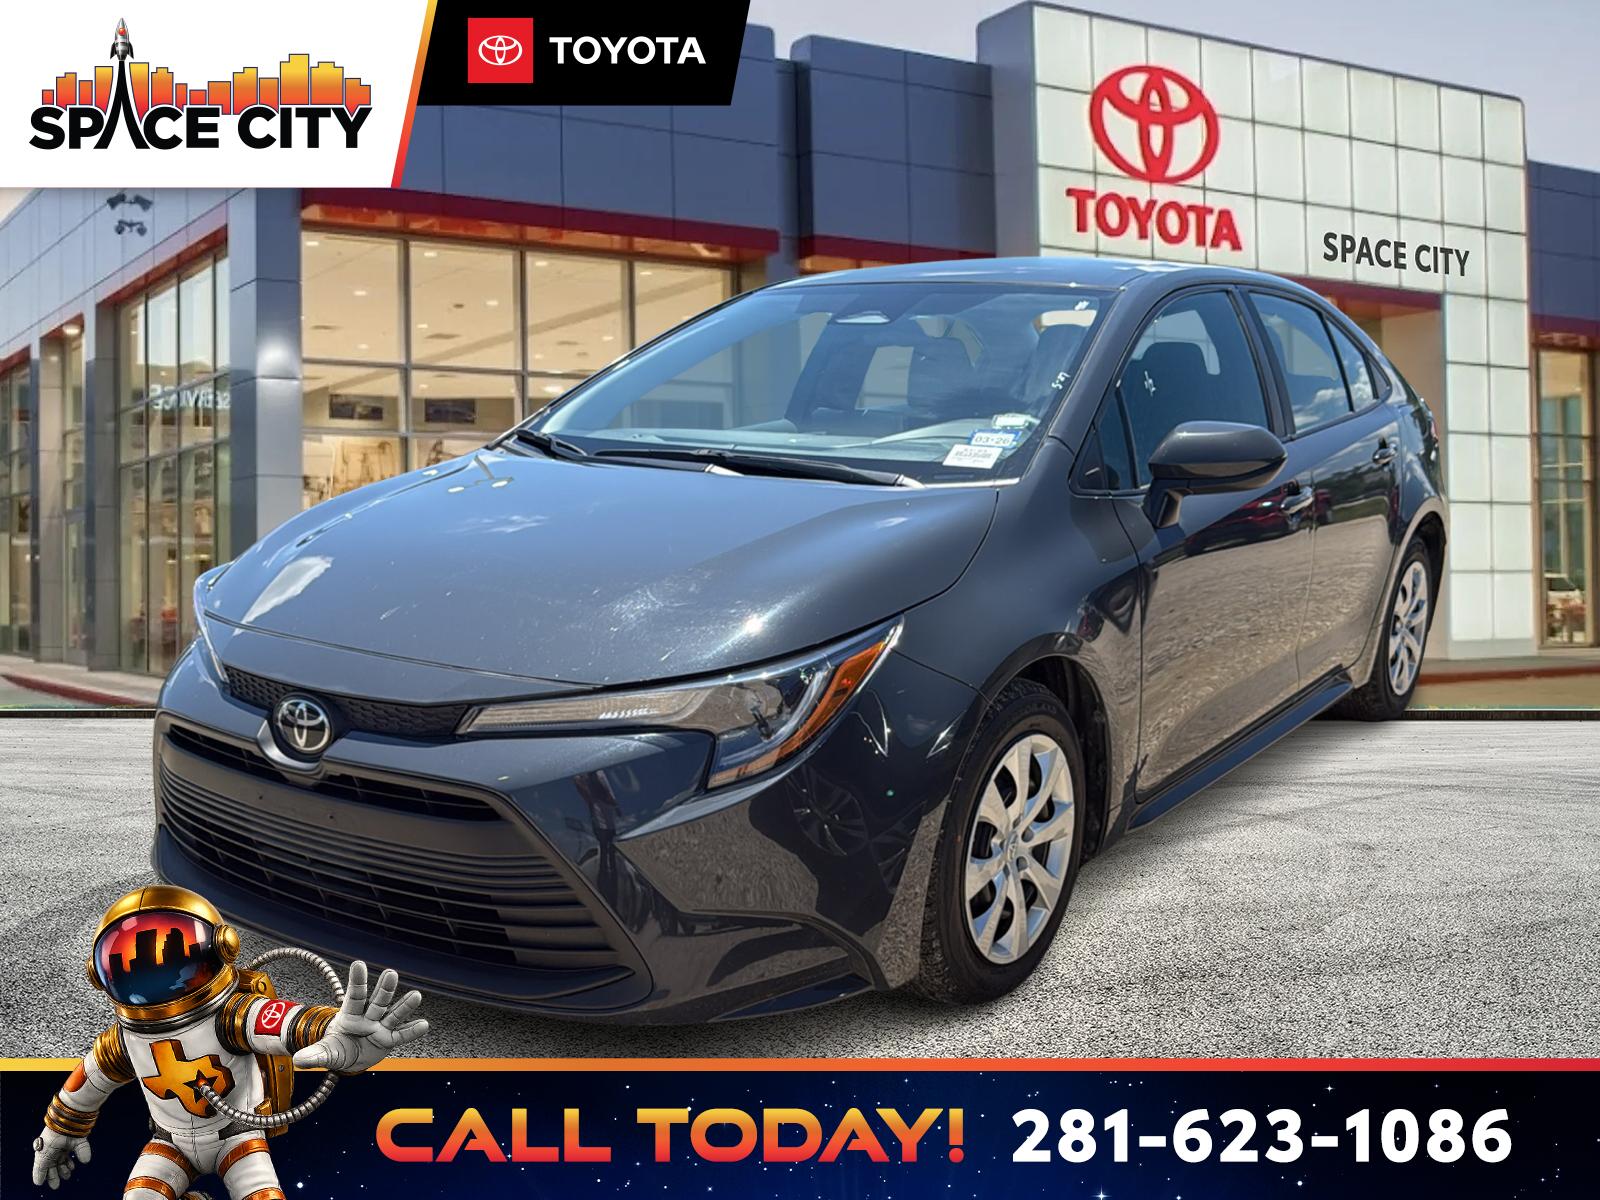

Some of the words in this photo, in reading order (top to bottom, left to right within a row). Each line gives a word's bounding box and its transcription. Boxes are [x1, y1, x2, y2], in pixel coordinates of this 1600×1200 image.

[1066, 187, 1242, 252] TOYOTA
[1322, 232, 1407, 271] SPACE
[1415, 244, 1470, 277] CITY
